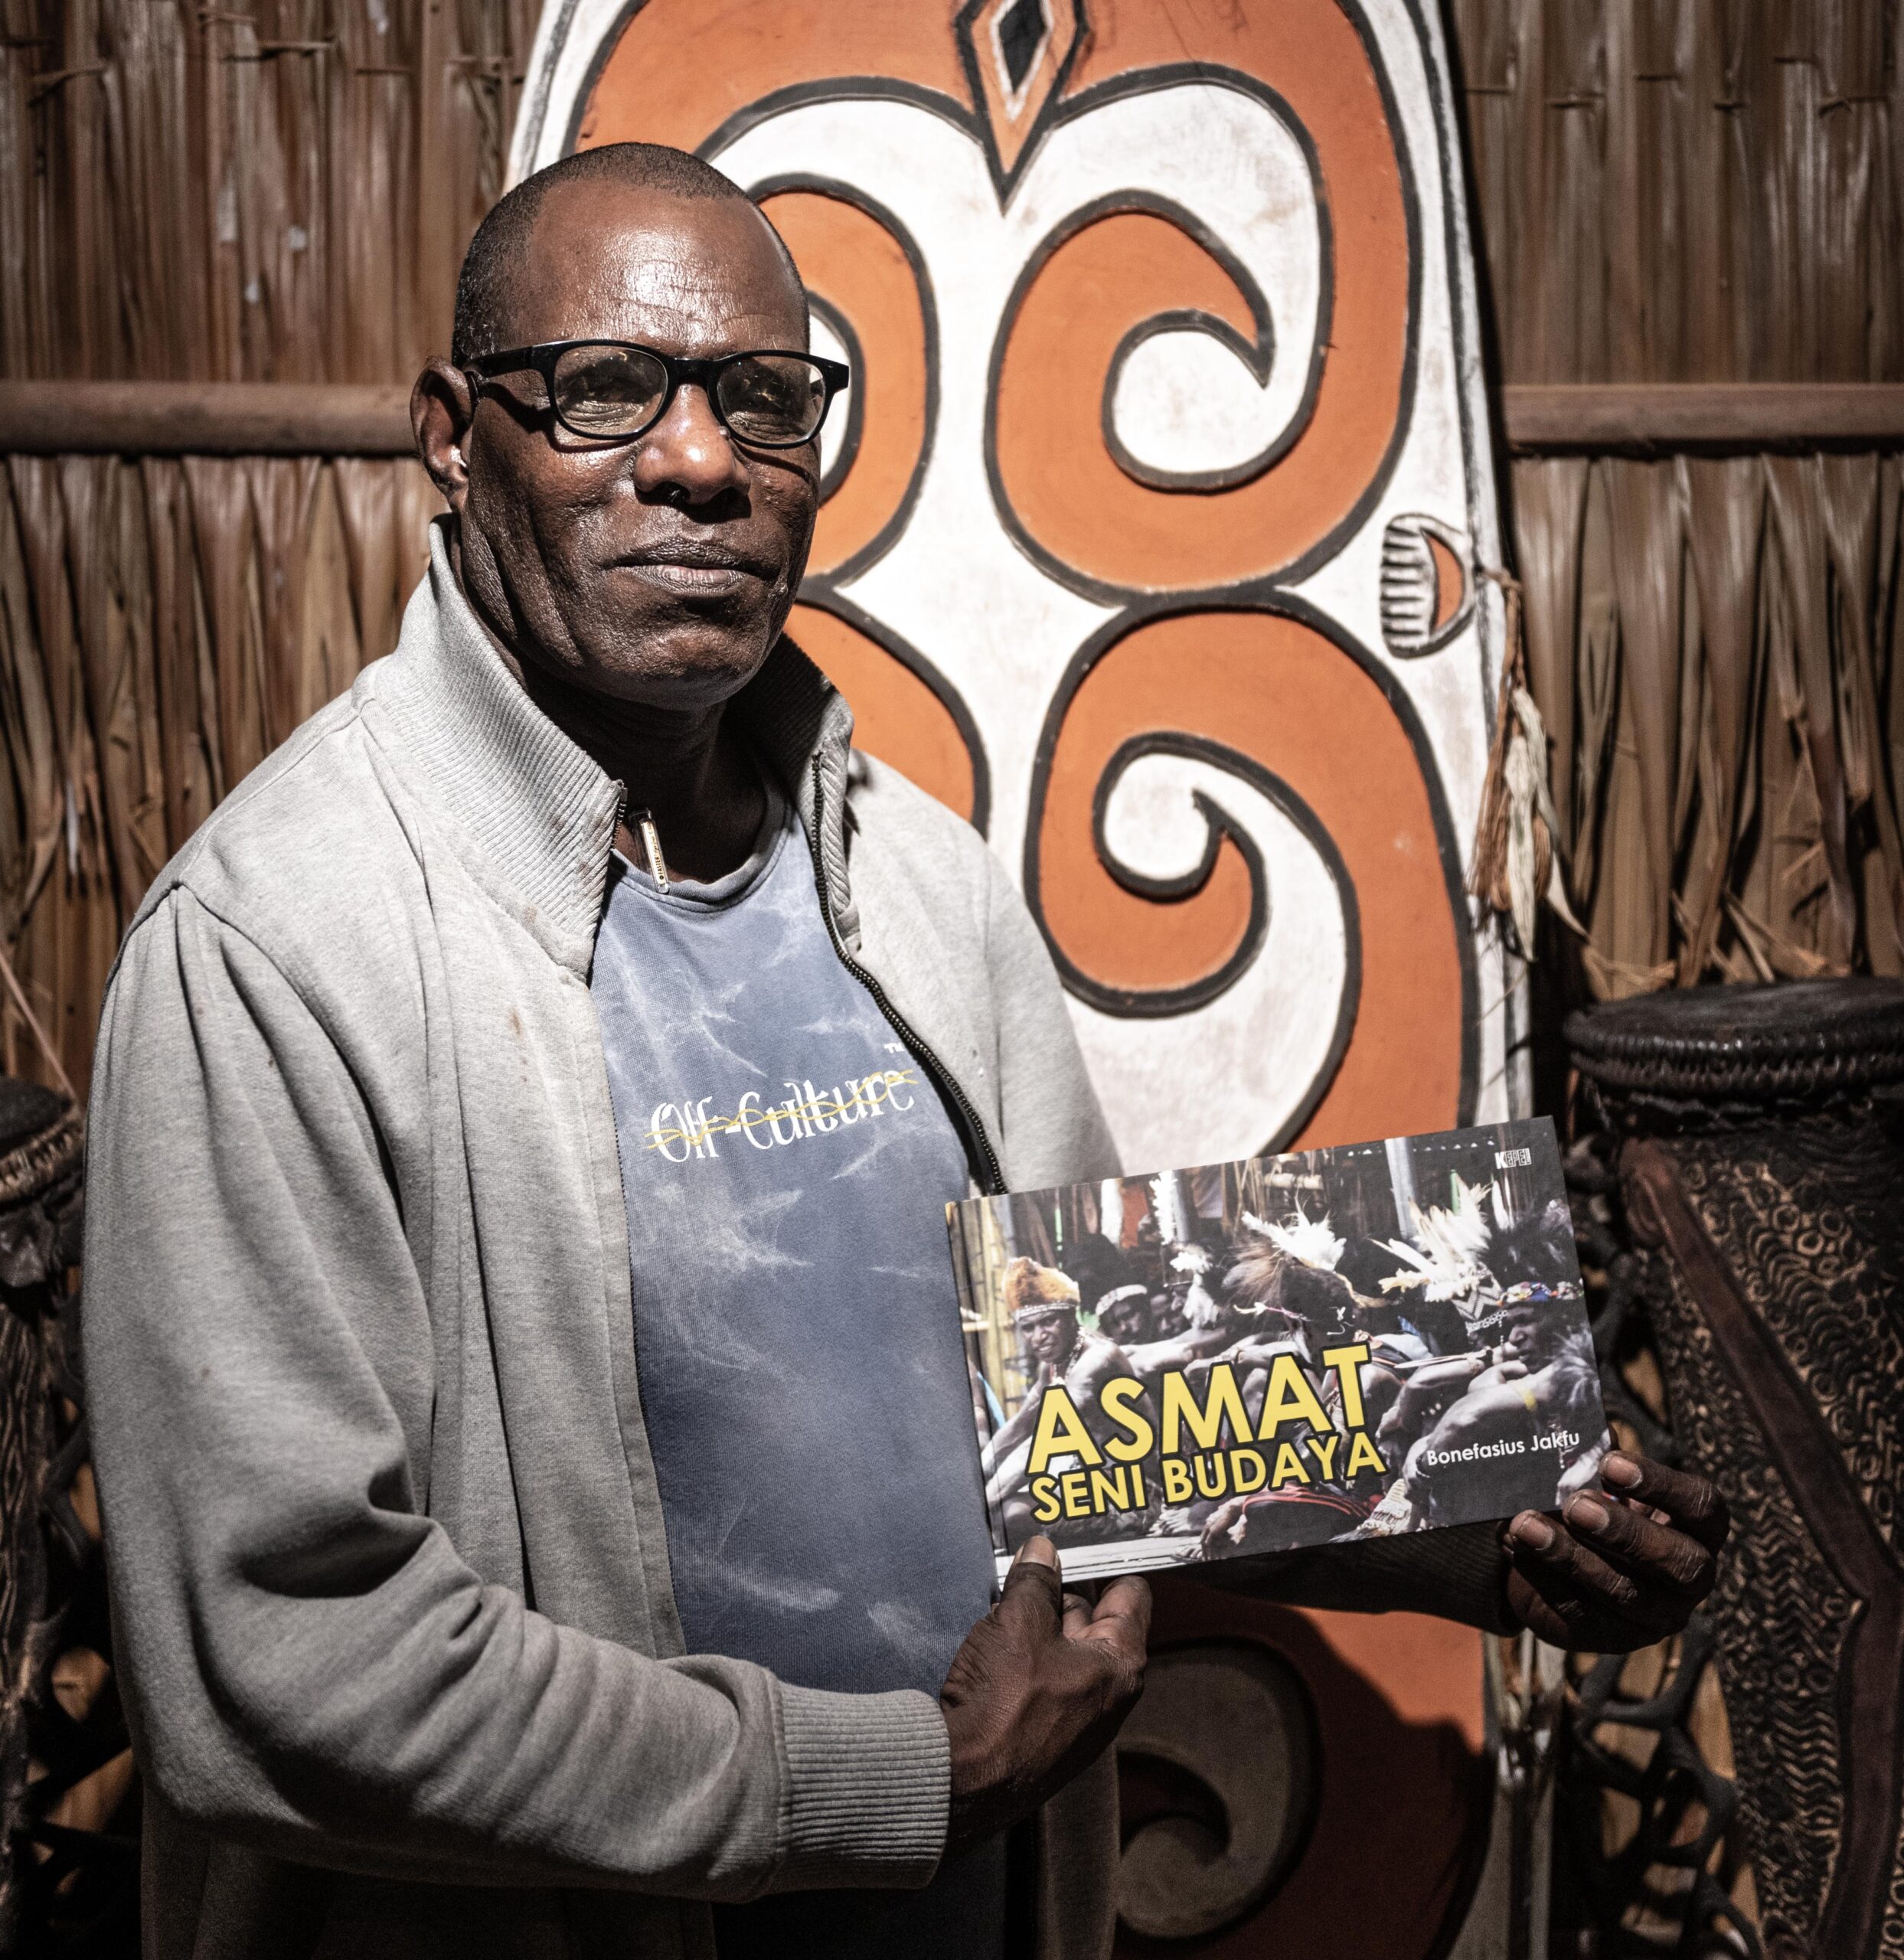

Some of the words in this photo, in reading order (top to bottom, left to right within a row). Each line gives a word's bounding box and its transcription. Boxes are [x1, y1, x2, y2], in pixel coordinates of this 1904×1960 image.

[1025, 1344, 1372, 1475] ASMAT
[1427, 1439, 1525, 1465] Bonefasius
[1530, 1430, 1579, 1451] Jakfu
[1029, 1464, 1148, 1523] SENI
[1160, 1431, 1388, 1504] BUDAYA
